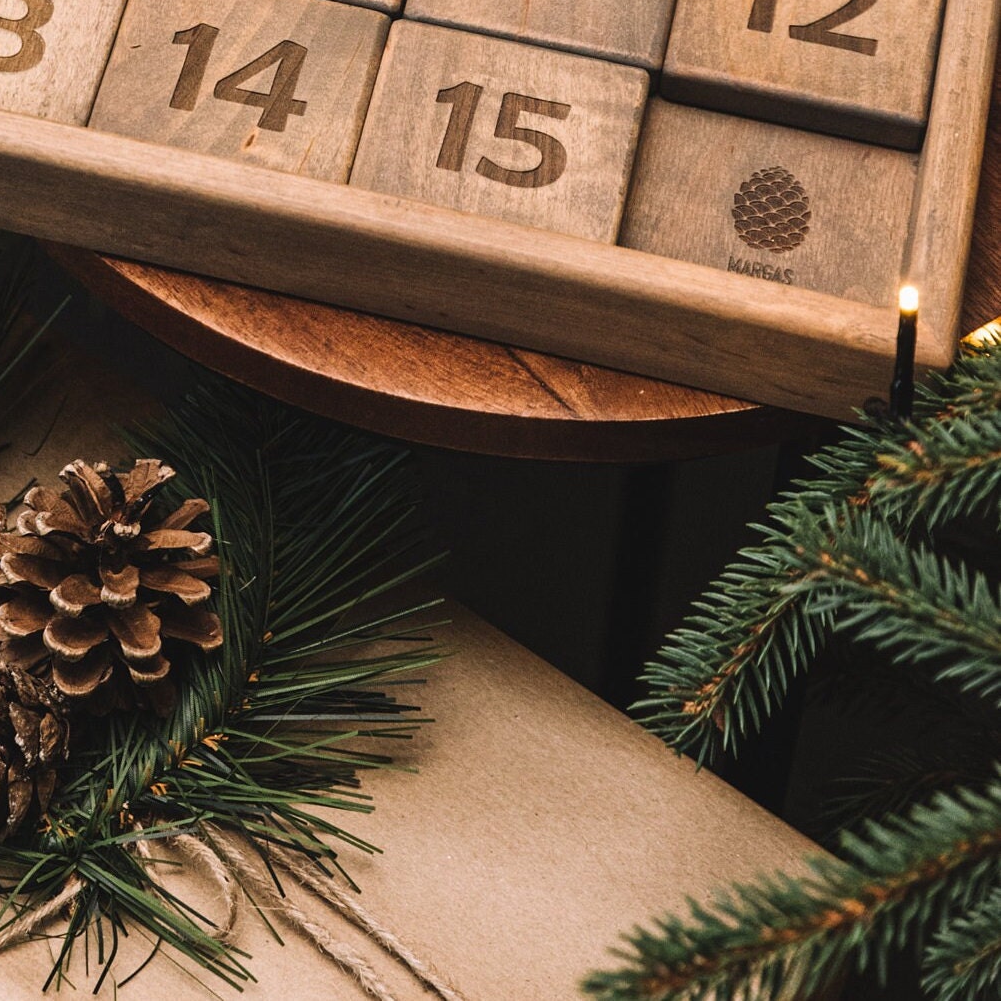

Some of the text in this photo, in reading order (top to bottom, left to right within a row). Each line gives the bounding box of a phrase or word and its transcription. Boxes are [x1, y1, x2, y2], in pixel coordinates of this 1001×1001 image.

[169, 22, 308, 132] 14
[435, 81, 571, 188] 15
[727, 256, 794, 284] MARGAS
